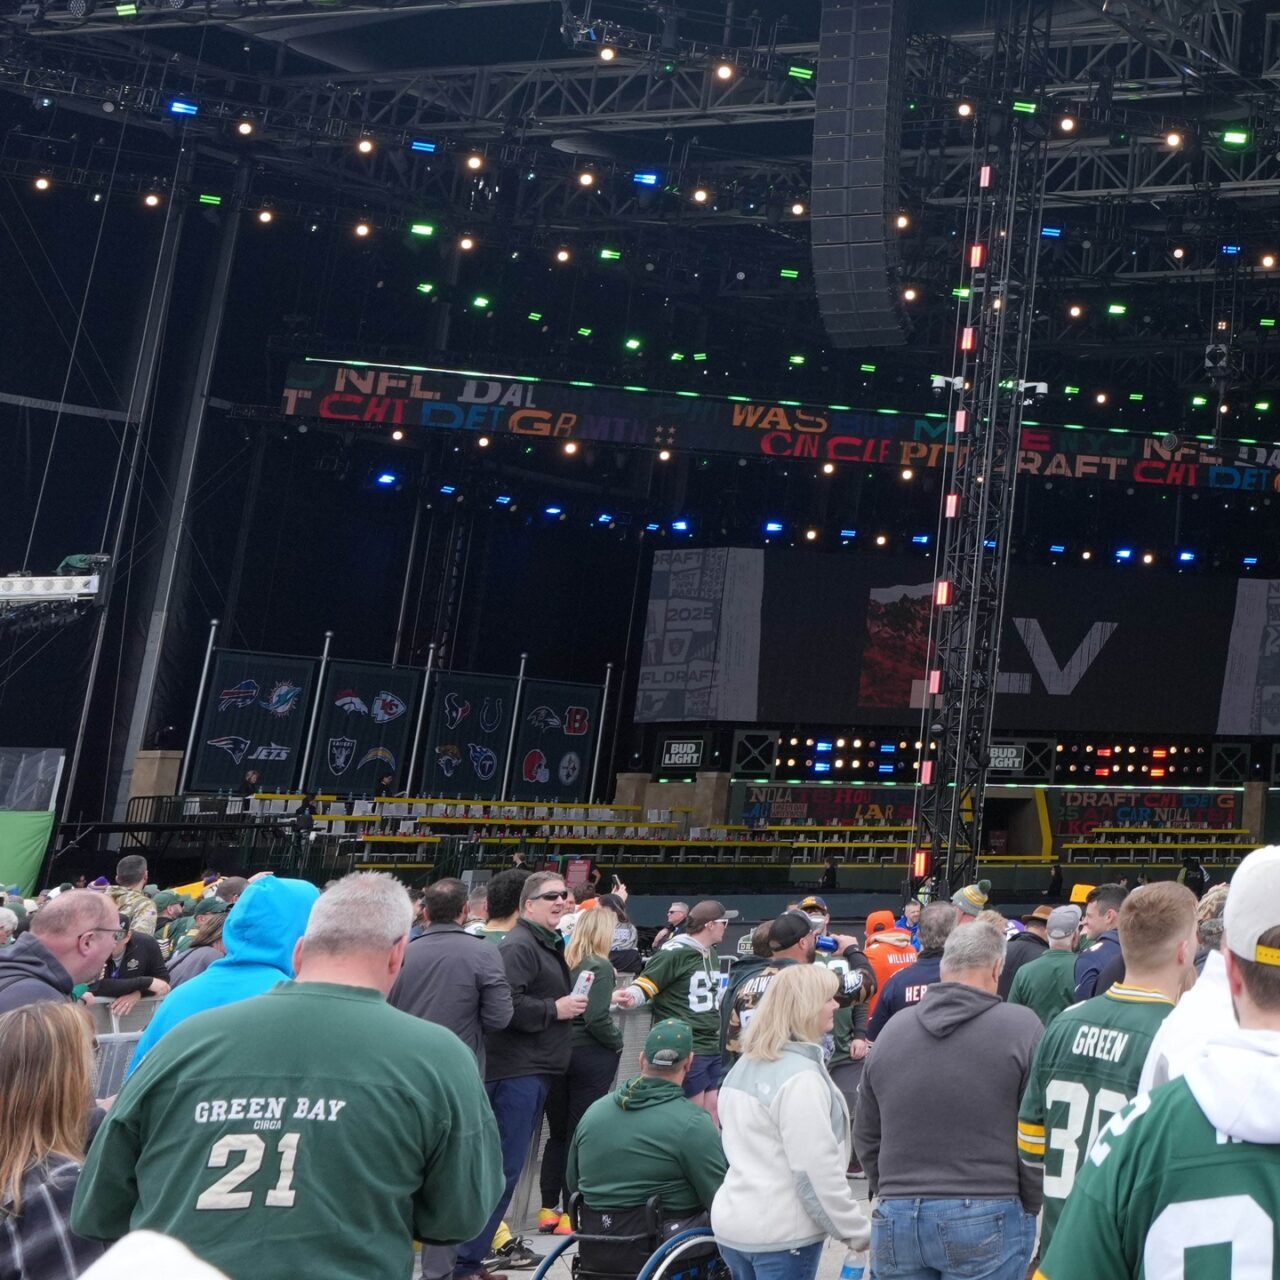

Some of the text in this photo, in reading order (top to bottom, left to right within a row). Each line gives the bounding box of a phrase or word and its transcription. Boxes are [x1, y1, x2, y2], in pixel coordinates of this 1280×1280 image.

[335, 368, 536, 407] NFL DAL
[421, 402, 505, 431] DET
[731, 404, 828, 433] WAS
[1000, 448, 1127, 481] RAFT
[1208, 465, 1270, 492] DET
[664, 752, 700, 766] LIGHT
[670, 743, 697, 755] BUD
[989, 756, 1022, 769] IGHT
[750, 787, 792, 803] NOLA
[1066, 792, 1141, 807] DRAFT
[855, 803, 895, 819] LAR
[1116, 806, 1191, 822] CAR NOLA
[1072, 1024, 1129, 1063] GREEN
[195, 1096, 346, 1124] GREEN BAY
[253, 1120, 282, 1131] CIRCA
[196, 1132, 301, 1210] 21
